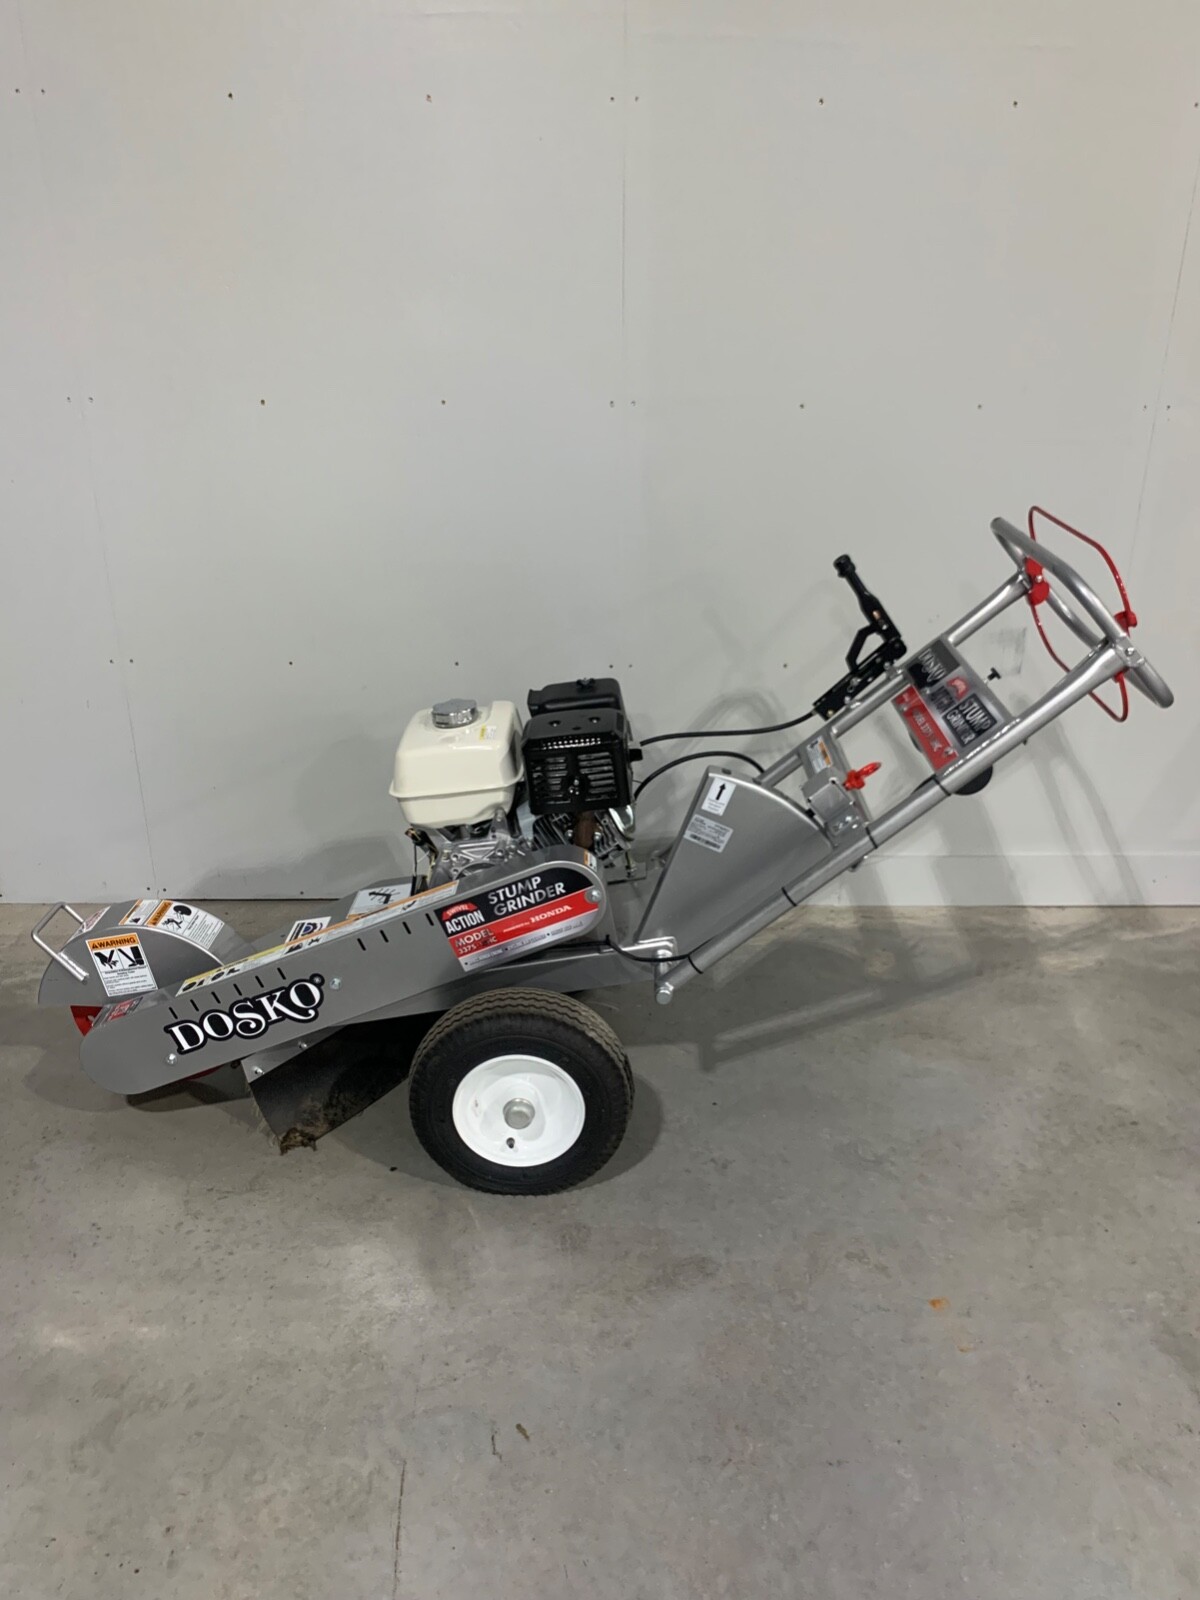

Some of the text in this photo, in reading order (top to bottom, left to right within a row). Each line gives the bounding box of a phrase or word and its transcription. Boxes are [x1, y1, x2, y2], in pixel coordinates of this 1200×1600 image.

[957, 700, 991, 732] STUMP
[488, 875, 542, 905] STUMP
[493, 881, 567, 916] GRINDER
[444, 909, 486, 935] ACTION
[529, 904, 573, 924] HONDA
[97, 936, 136, 948] WARNING
[454, 928, 495, 948] MODEL
[167, 981, 322, 1052] DOSKO
